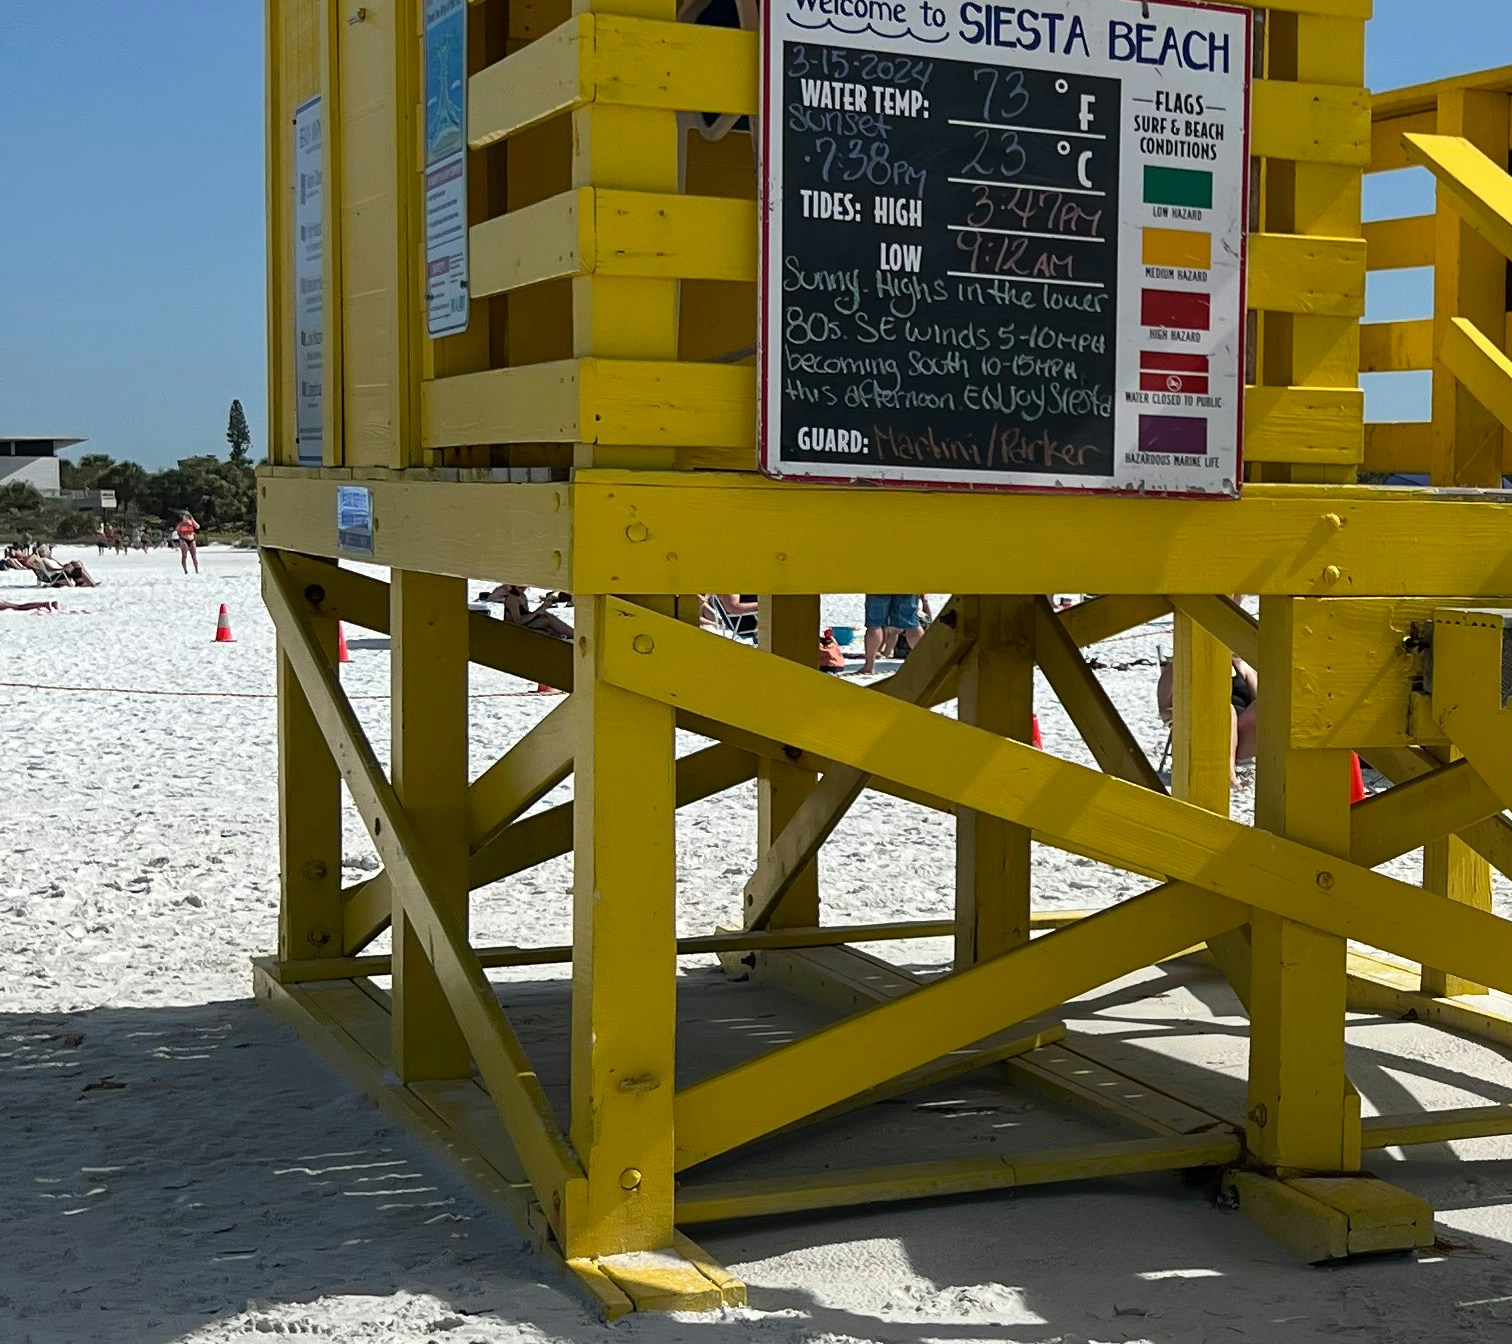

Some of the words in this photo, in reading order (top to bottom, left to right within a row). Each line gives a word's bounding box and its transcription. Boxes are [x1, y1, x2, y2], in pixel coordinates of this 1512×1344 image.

[919, 0, 946, 28] to
[959, 1, 1090, 58] SIESTA
[1108, 19, 1230, 74] BEACH
[787, 44, 934, 92] 3-15-2024
[799, 77, 867, 113] WATER
[871, 85, 930, 119] TEMP:
[973, 66, 1030, 122] 73
[1155, 90, 1204, 116] FLAGS
[788, 102, 893, 140] Sunset
[1133, 114, 1168, 135] SURF
[1170, 118, 1181, 136] &
[1184, 120, 1225, 141] BEACH
[961, 128, 1027, 177] 23
[1139, 136, 1217, 161] CONDITIONS
[799, 189, 861, 222] TIDES:
[874, 195, 923, 228] HIGH
[1152, 205, 1169, 218] LOW
[1171, 207, 1203, 222] HAZARD
[879, 241, 923, 274] LOW
[1145, 267, 1175, 281] MEDIUM
[1176, 269, 1208, 283] HAZARD
[875, 269, 949, 319] Highs
[957, 281, 985, 306] in
[986, 278, 1037, 310] the
[854, 311, 898, 344] SE
[1149, 328, 1168, 341] HIGH
[1170, 330, 1202, 344] HAZARD
[784, 343, 902, 394] becoming
[907, 349, 970, 379] South
[784, 377, 838, 406] this
[1124, 391, 1150, 404] WATER
[1151, 393, 1182, 406] CLOSED
[1184, 395, 1194, 407] TO
[1196, 396, 1223, 408] PUBLIC
[797, 425, 869, 454] GUARD:
[1124, 452, 1171, 466] HAZARDOUS
[1173, 454, 1202, 468] MARINE
[1204, 456, 1220, 469] LIFE
